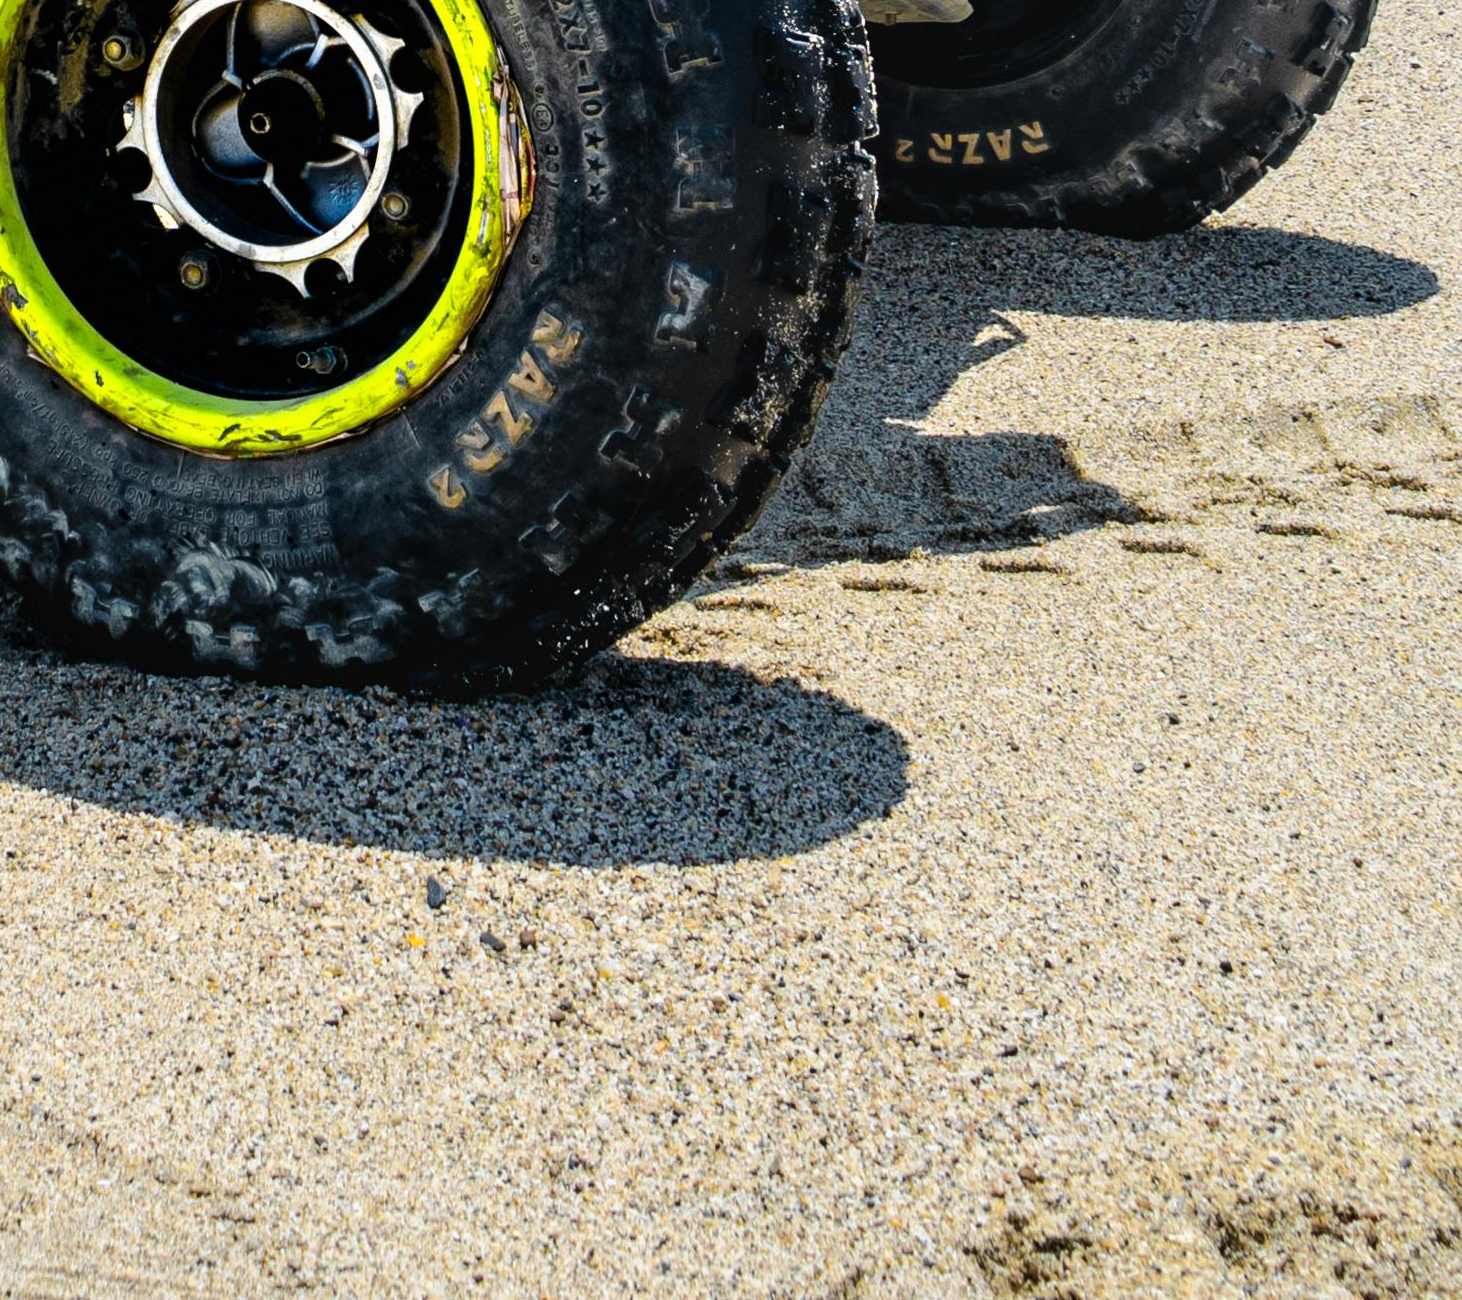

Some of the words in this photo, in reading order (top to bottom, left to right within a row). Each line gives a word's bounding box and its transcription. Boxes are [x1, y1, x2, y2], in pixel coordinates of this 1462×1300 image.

[896, 139, 915, 163] 2
[928, 121, 1049, 165] RAZR
[455, 306, 583, 474] RAZR
[429, 465, 469, 510] 2
[224, 510, 258, 528] FOR
